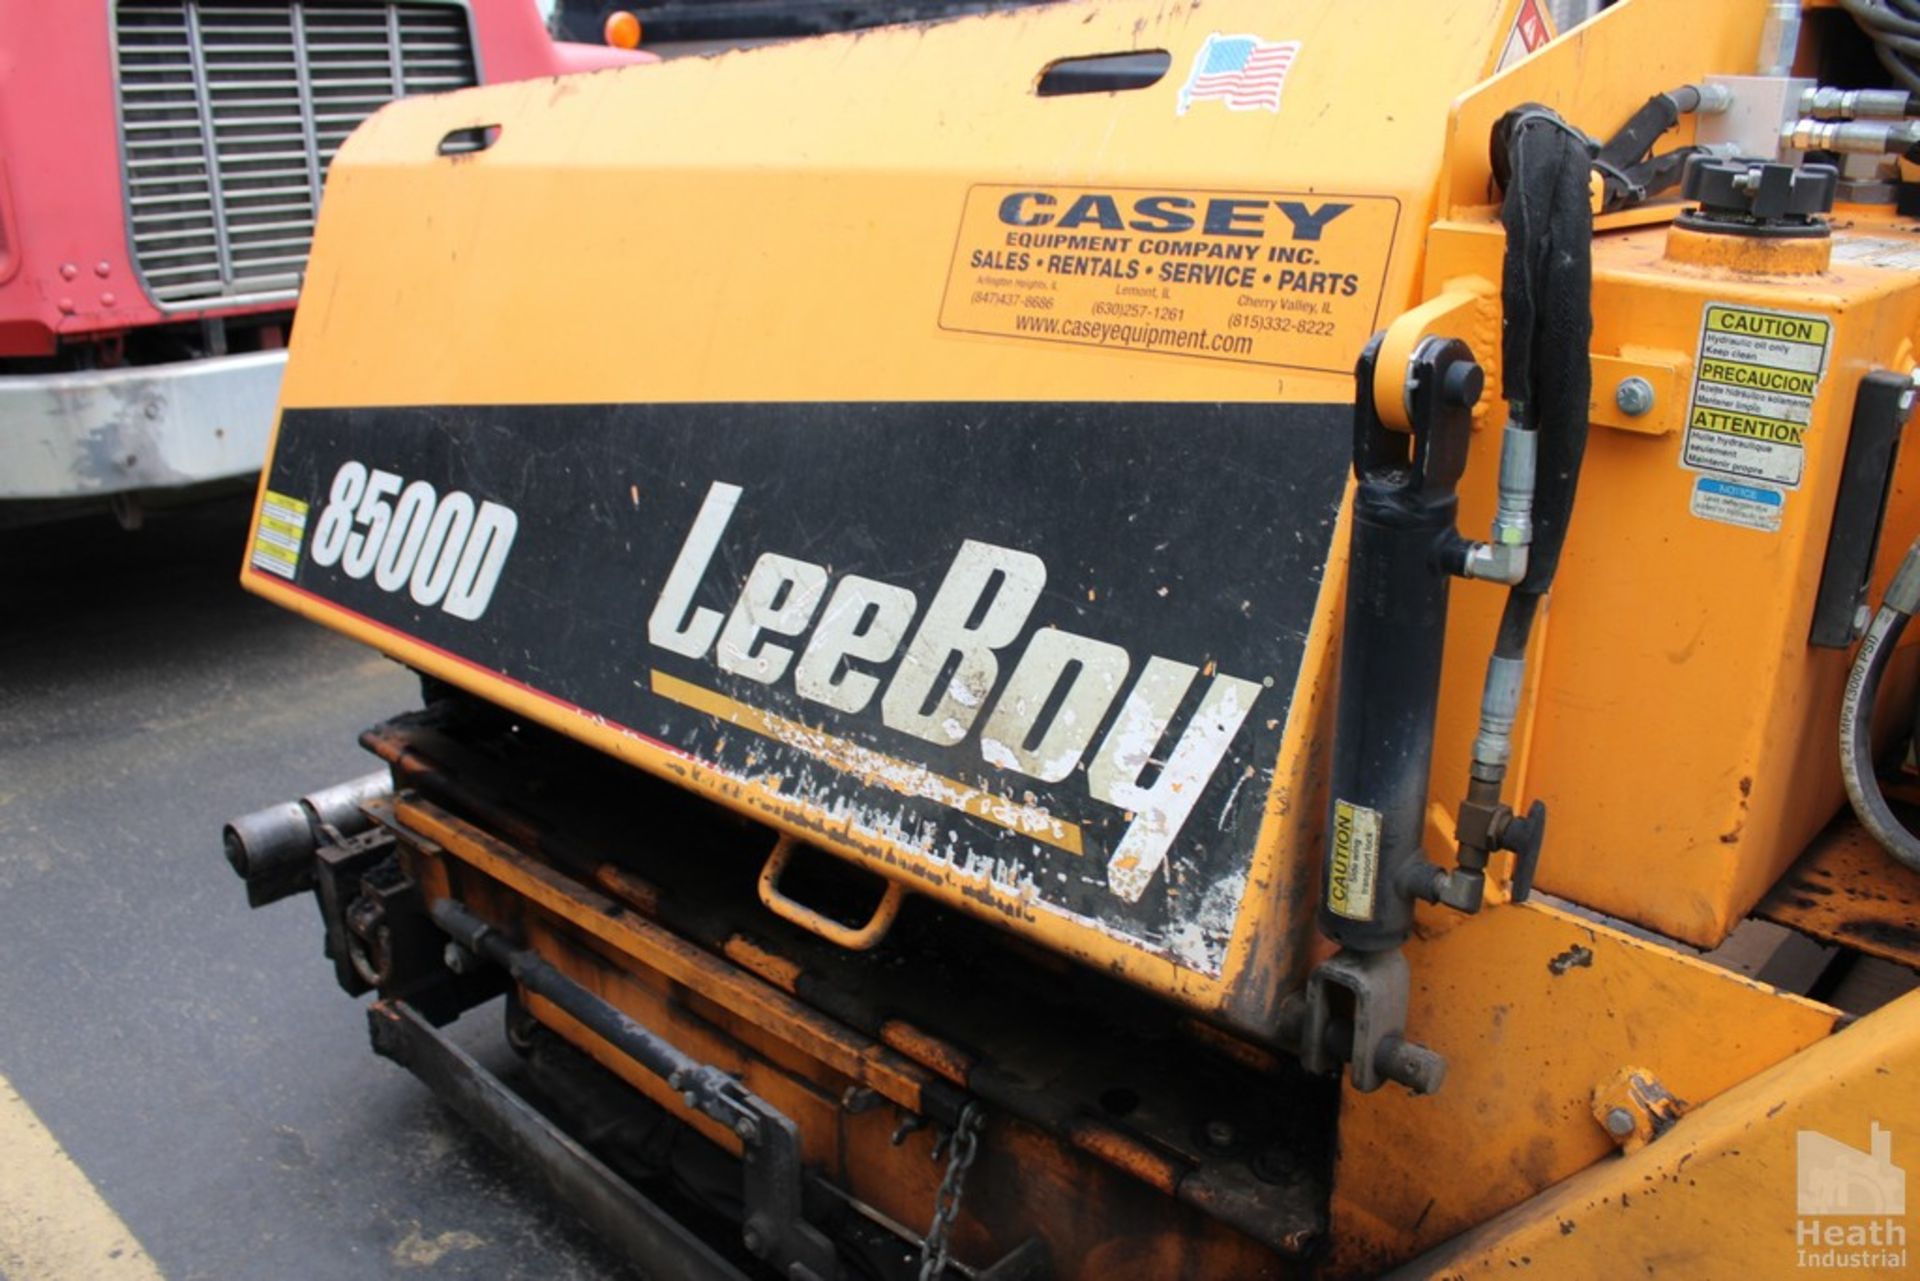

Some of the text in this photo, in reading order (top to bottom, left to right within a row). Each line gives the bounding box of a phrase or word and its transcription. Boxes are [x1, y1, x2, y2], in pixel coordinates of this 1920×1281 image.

[999, 192, 1354, 241] CASEY
[1006, 232, 1320, 265] EQUIPMENT COMPANY INC.
[971, 249, 1359, 297] SALES RENTALS SERVICE PARTS
[1115, 284, 1157, 298] Lemont,
[1237, 294, 1333, 314] Cherry Valley, IL
[1092, 301, 1184, 321] (630)257-1261
[1228, 313, 1335, 336] (815)332-8222
[1016, 315, 1253, 354] www.caseyequipment.com
[1720, 313, 1813, 340] CAUTION
[1706, 345, 1757, 360] Keep clean
[1707, 334, 1790, 354] Hydraulic oil only
[1701, 362, 1814, 394] PRECAUCION
[1693, 411, 1803, 441] ATTENTION
[310, 460, 519, 621] 8500D
[1859, 634, 1879, 663] PSI)
[647, 480, 1263, 902] LeeBoy
[1847, 664, 1865, 704] (3000
[1841, 706, 1854, 736] MPa
[1333, 815, 1351, 901] CAUTION
